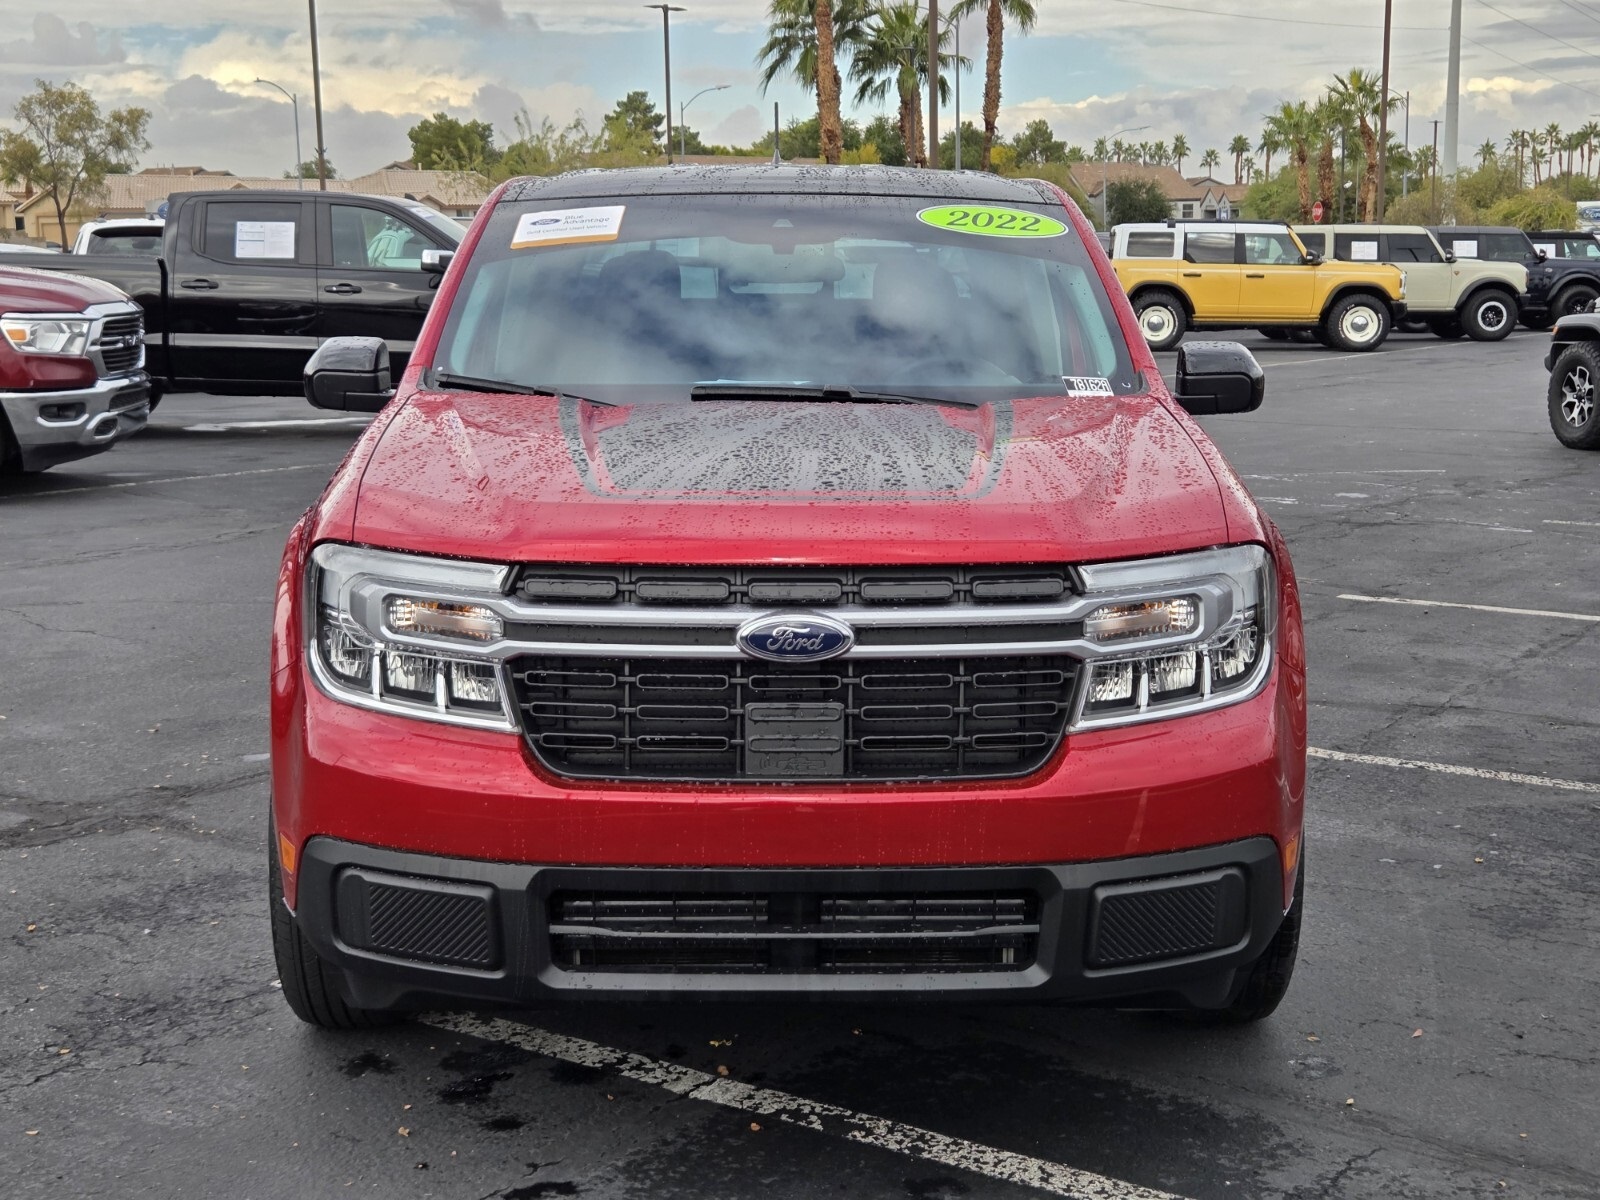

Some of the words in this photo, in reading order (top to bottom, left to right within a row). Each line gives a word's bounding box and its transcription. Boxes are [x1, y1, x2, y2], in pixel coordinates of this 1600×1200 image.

[563, 217, 610, 225] Advantage
[946, 210, 1041, 232] 2022
[766, 626, 825, 651] Ford
